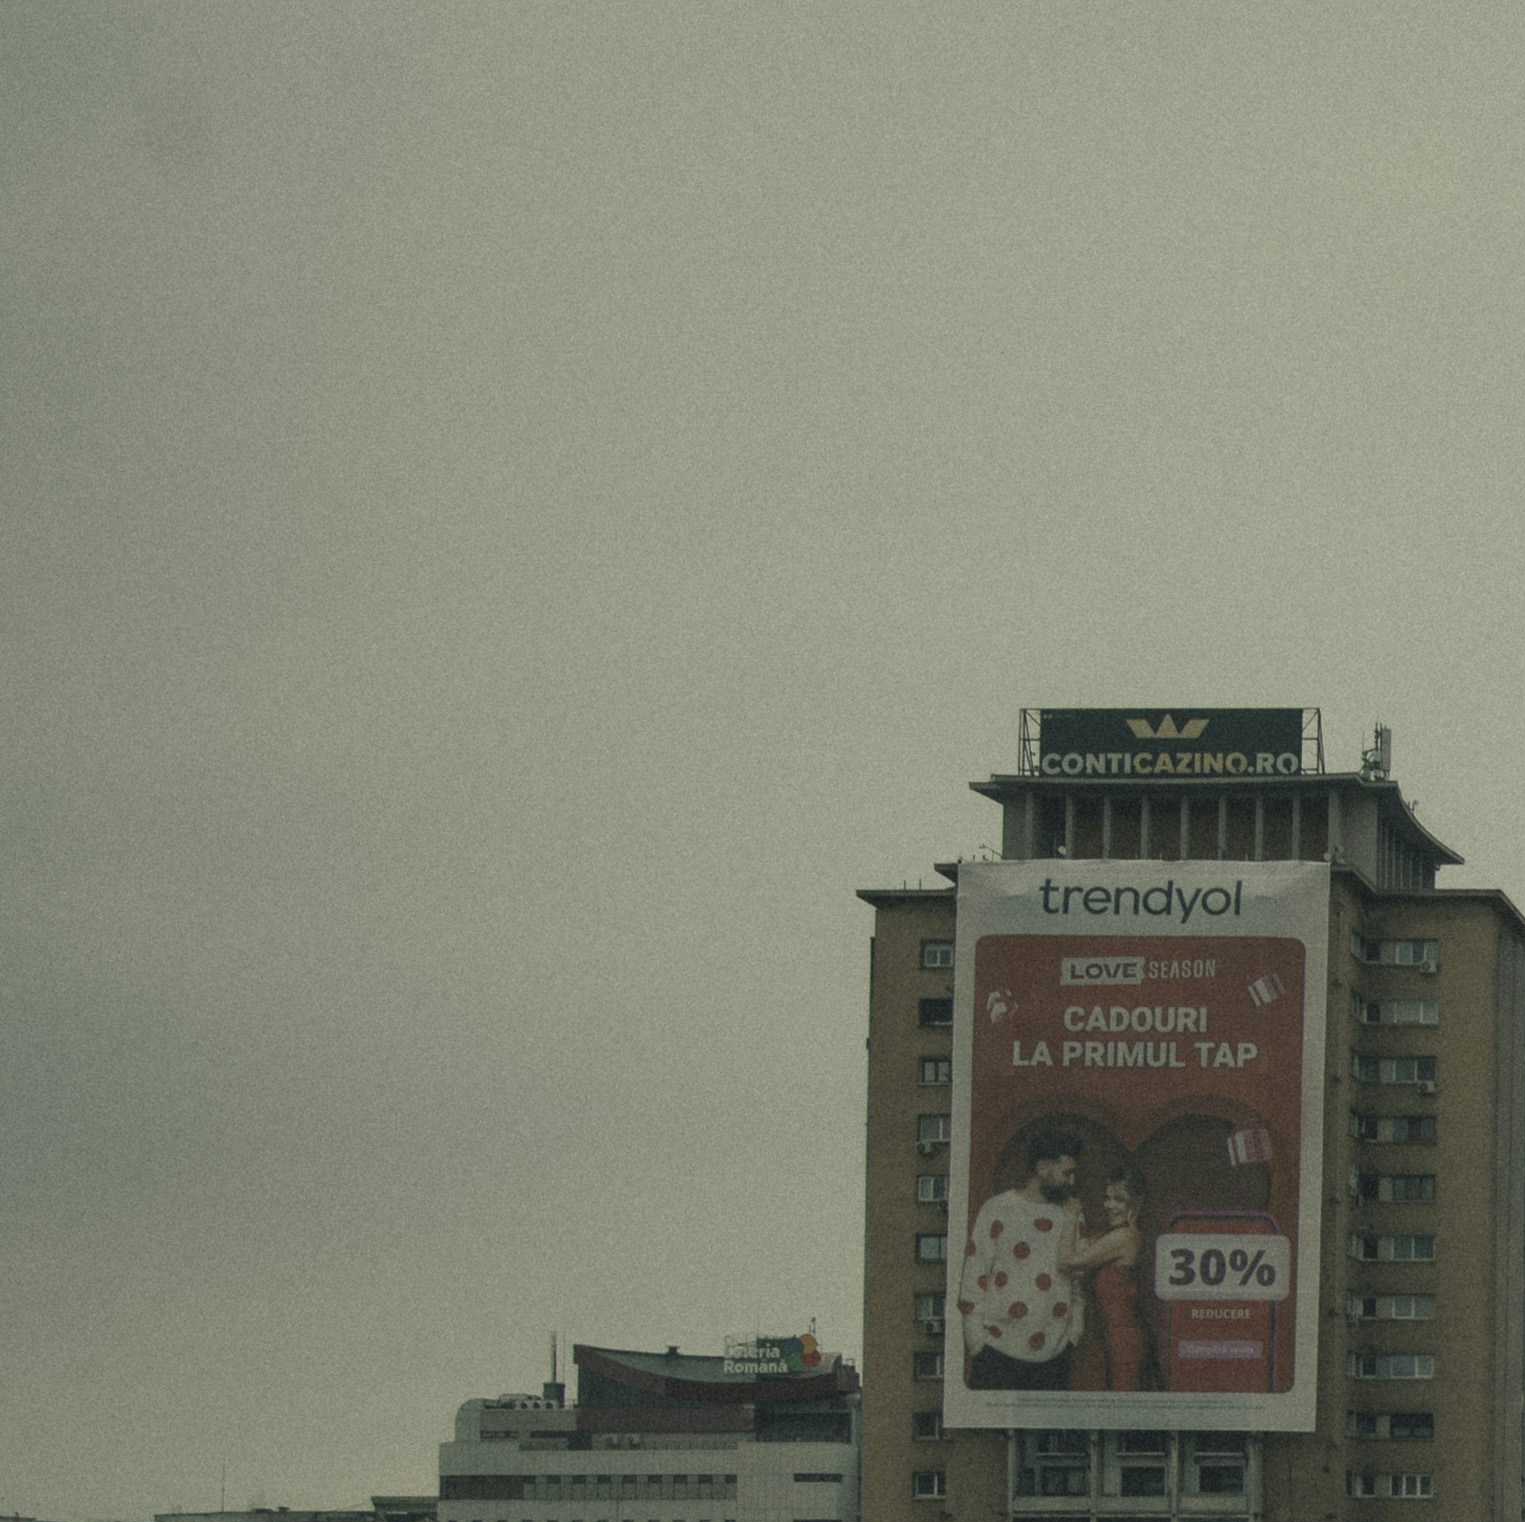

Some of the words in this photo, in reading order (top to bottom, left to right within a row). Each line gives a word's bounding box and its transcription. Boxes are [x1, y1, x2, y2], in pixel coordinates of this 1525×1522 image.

[1041, 751, 1299, 775] CONTICAZINO.RO
[1038, 878, 1243, 924] trendyol
[1069, 962, 1138, 980] LOVE
[1148, 959, 1217, 980] SEASON
[1062, 1005, 1208, 1033] CADOURI
[1011, 1040, 1054, 1067] LA
[1061, 1041, 1187, 1069] PRIMUL
[1194, 1041, 1259, 1069] TAP
[1167, 1248, 1276, 1287] 30%
[1190, 1308, 1252, 1319] REDUCERE
[723, 1359, 789, 1374] Română
